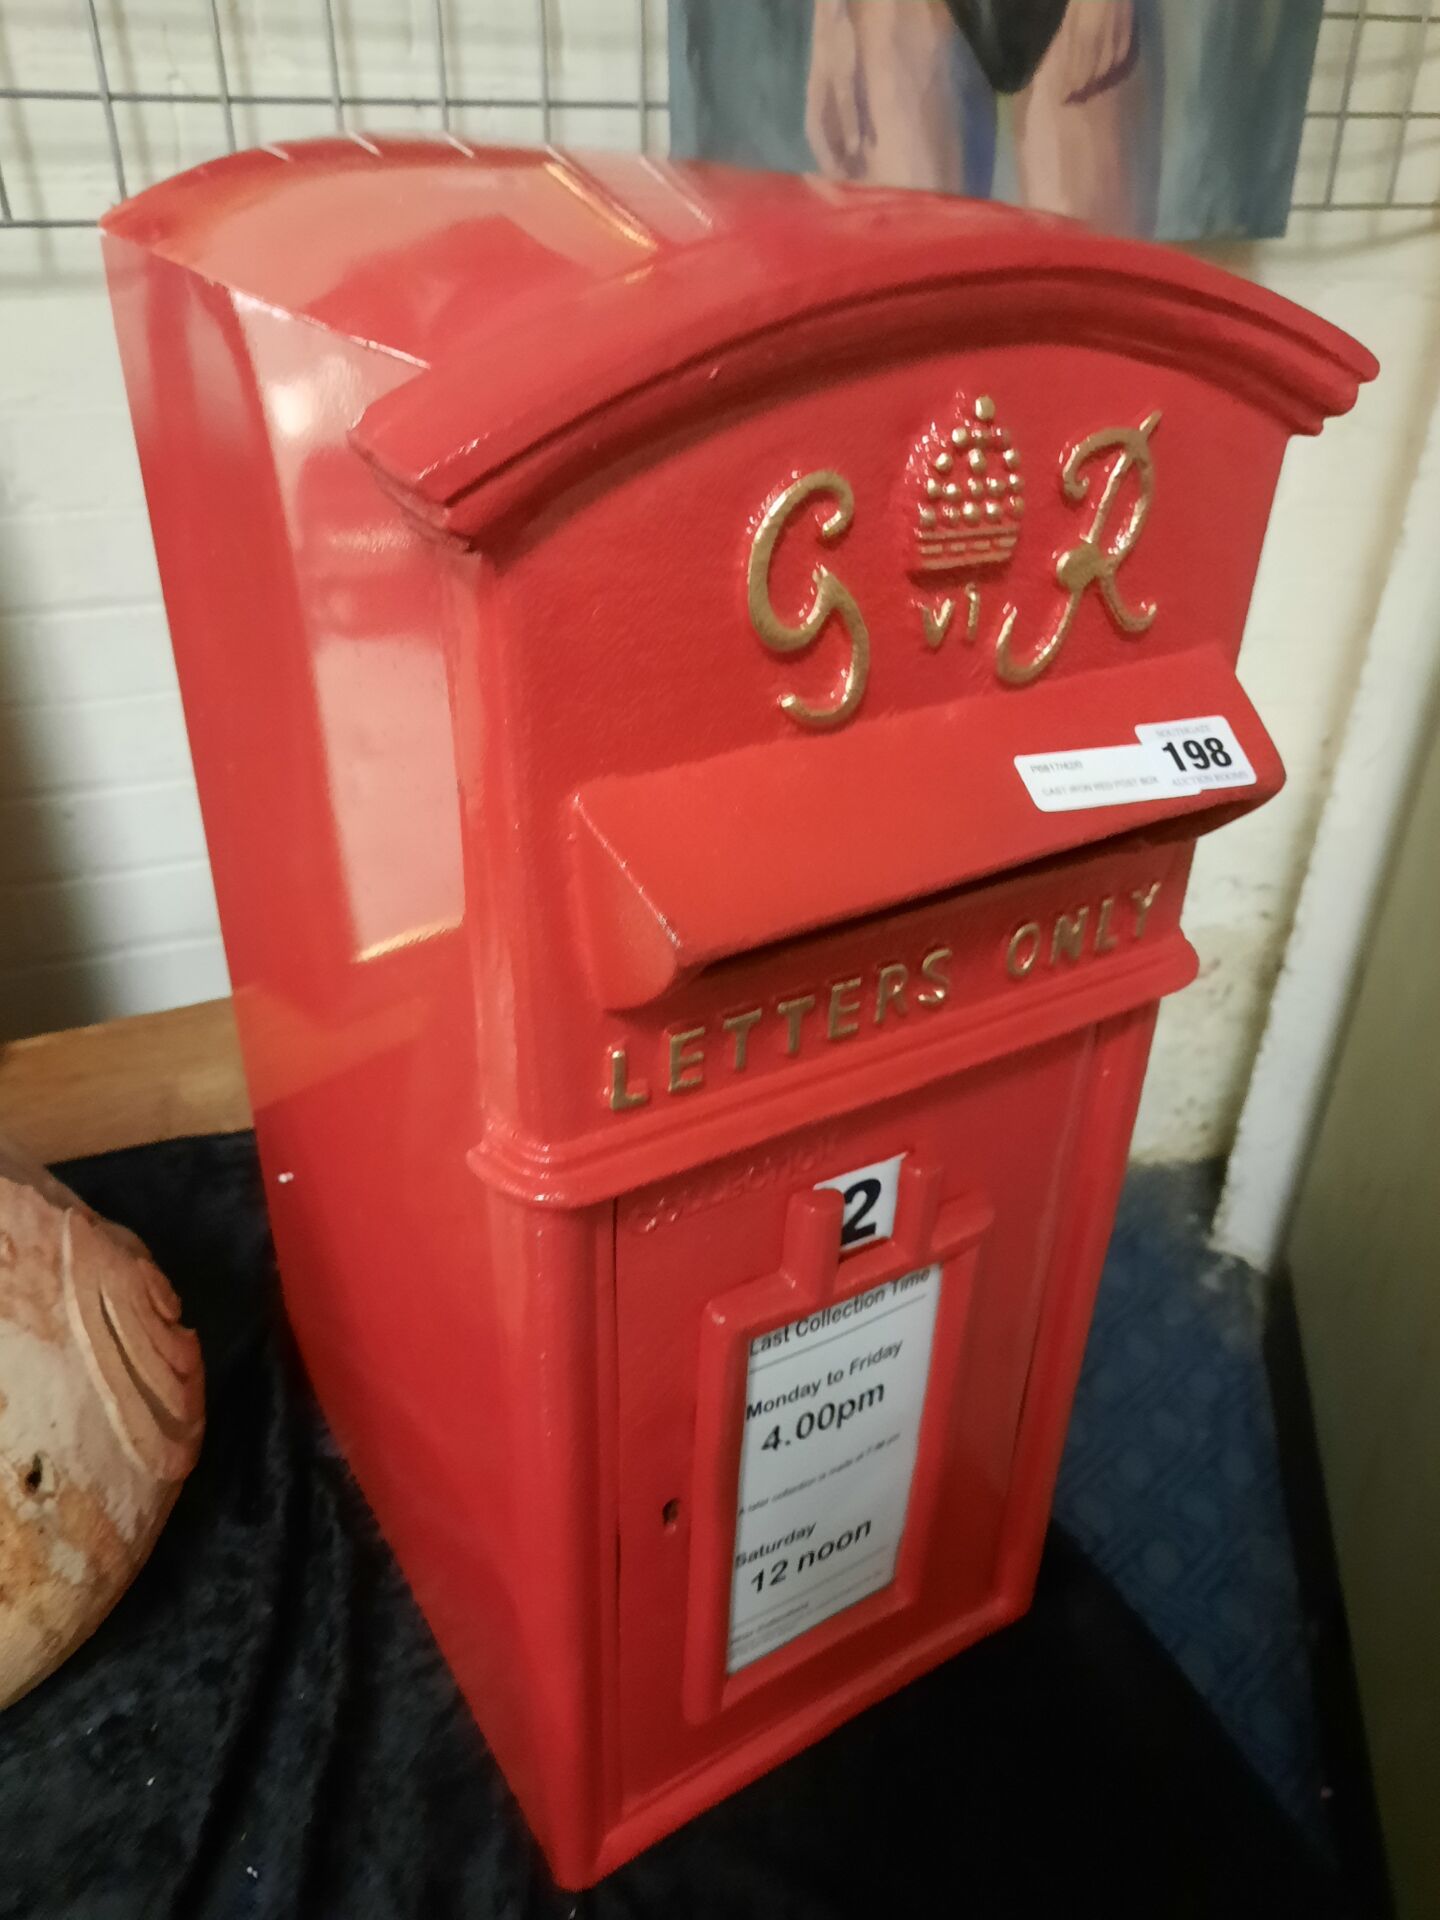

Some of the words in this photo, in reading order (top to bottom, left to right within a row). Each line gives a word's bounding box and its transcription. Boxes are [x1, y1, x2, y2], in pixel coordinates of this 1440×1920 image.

[747, 470, 870, 724] G
[996, 410, 1162, 684] R
[1161, 736, 1233, 773] 198
[607, 944, 953, 1111] LETTERS
[1005, 881, 1161, 977] ONLY
[840, 1177, 882, 1246] 2
[750, 1323, 790, 1356] Last
[796, 1289, 885, 1337] Collection
[890, 1268, 931, 1297] Time
[746, 1378, 822, 1420] Monday
[827, 1369, 844, 1387] to
[849, 1340, 904, 1375] Friday
[761, 1382, 885, 1452] 4.00pm
[735, 1522, 817, 1568] Saturday
[750, 1560, 789, 1593] 12
[797, 1519, 872, 1573] noon
